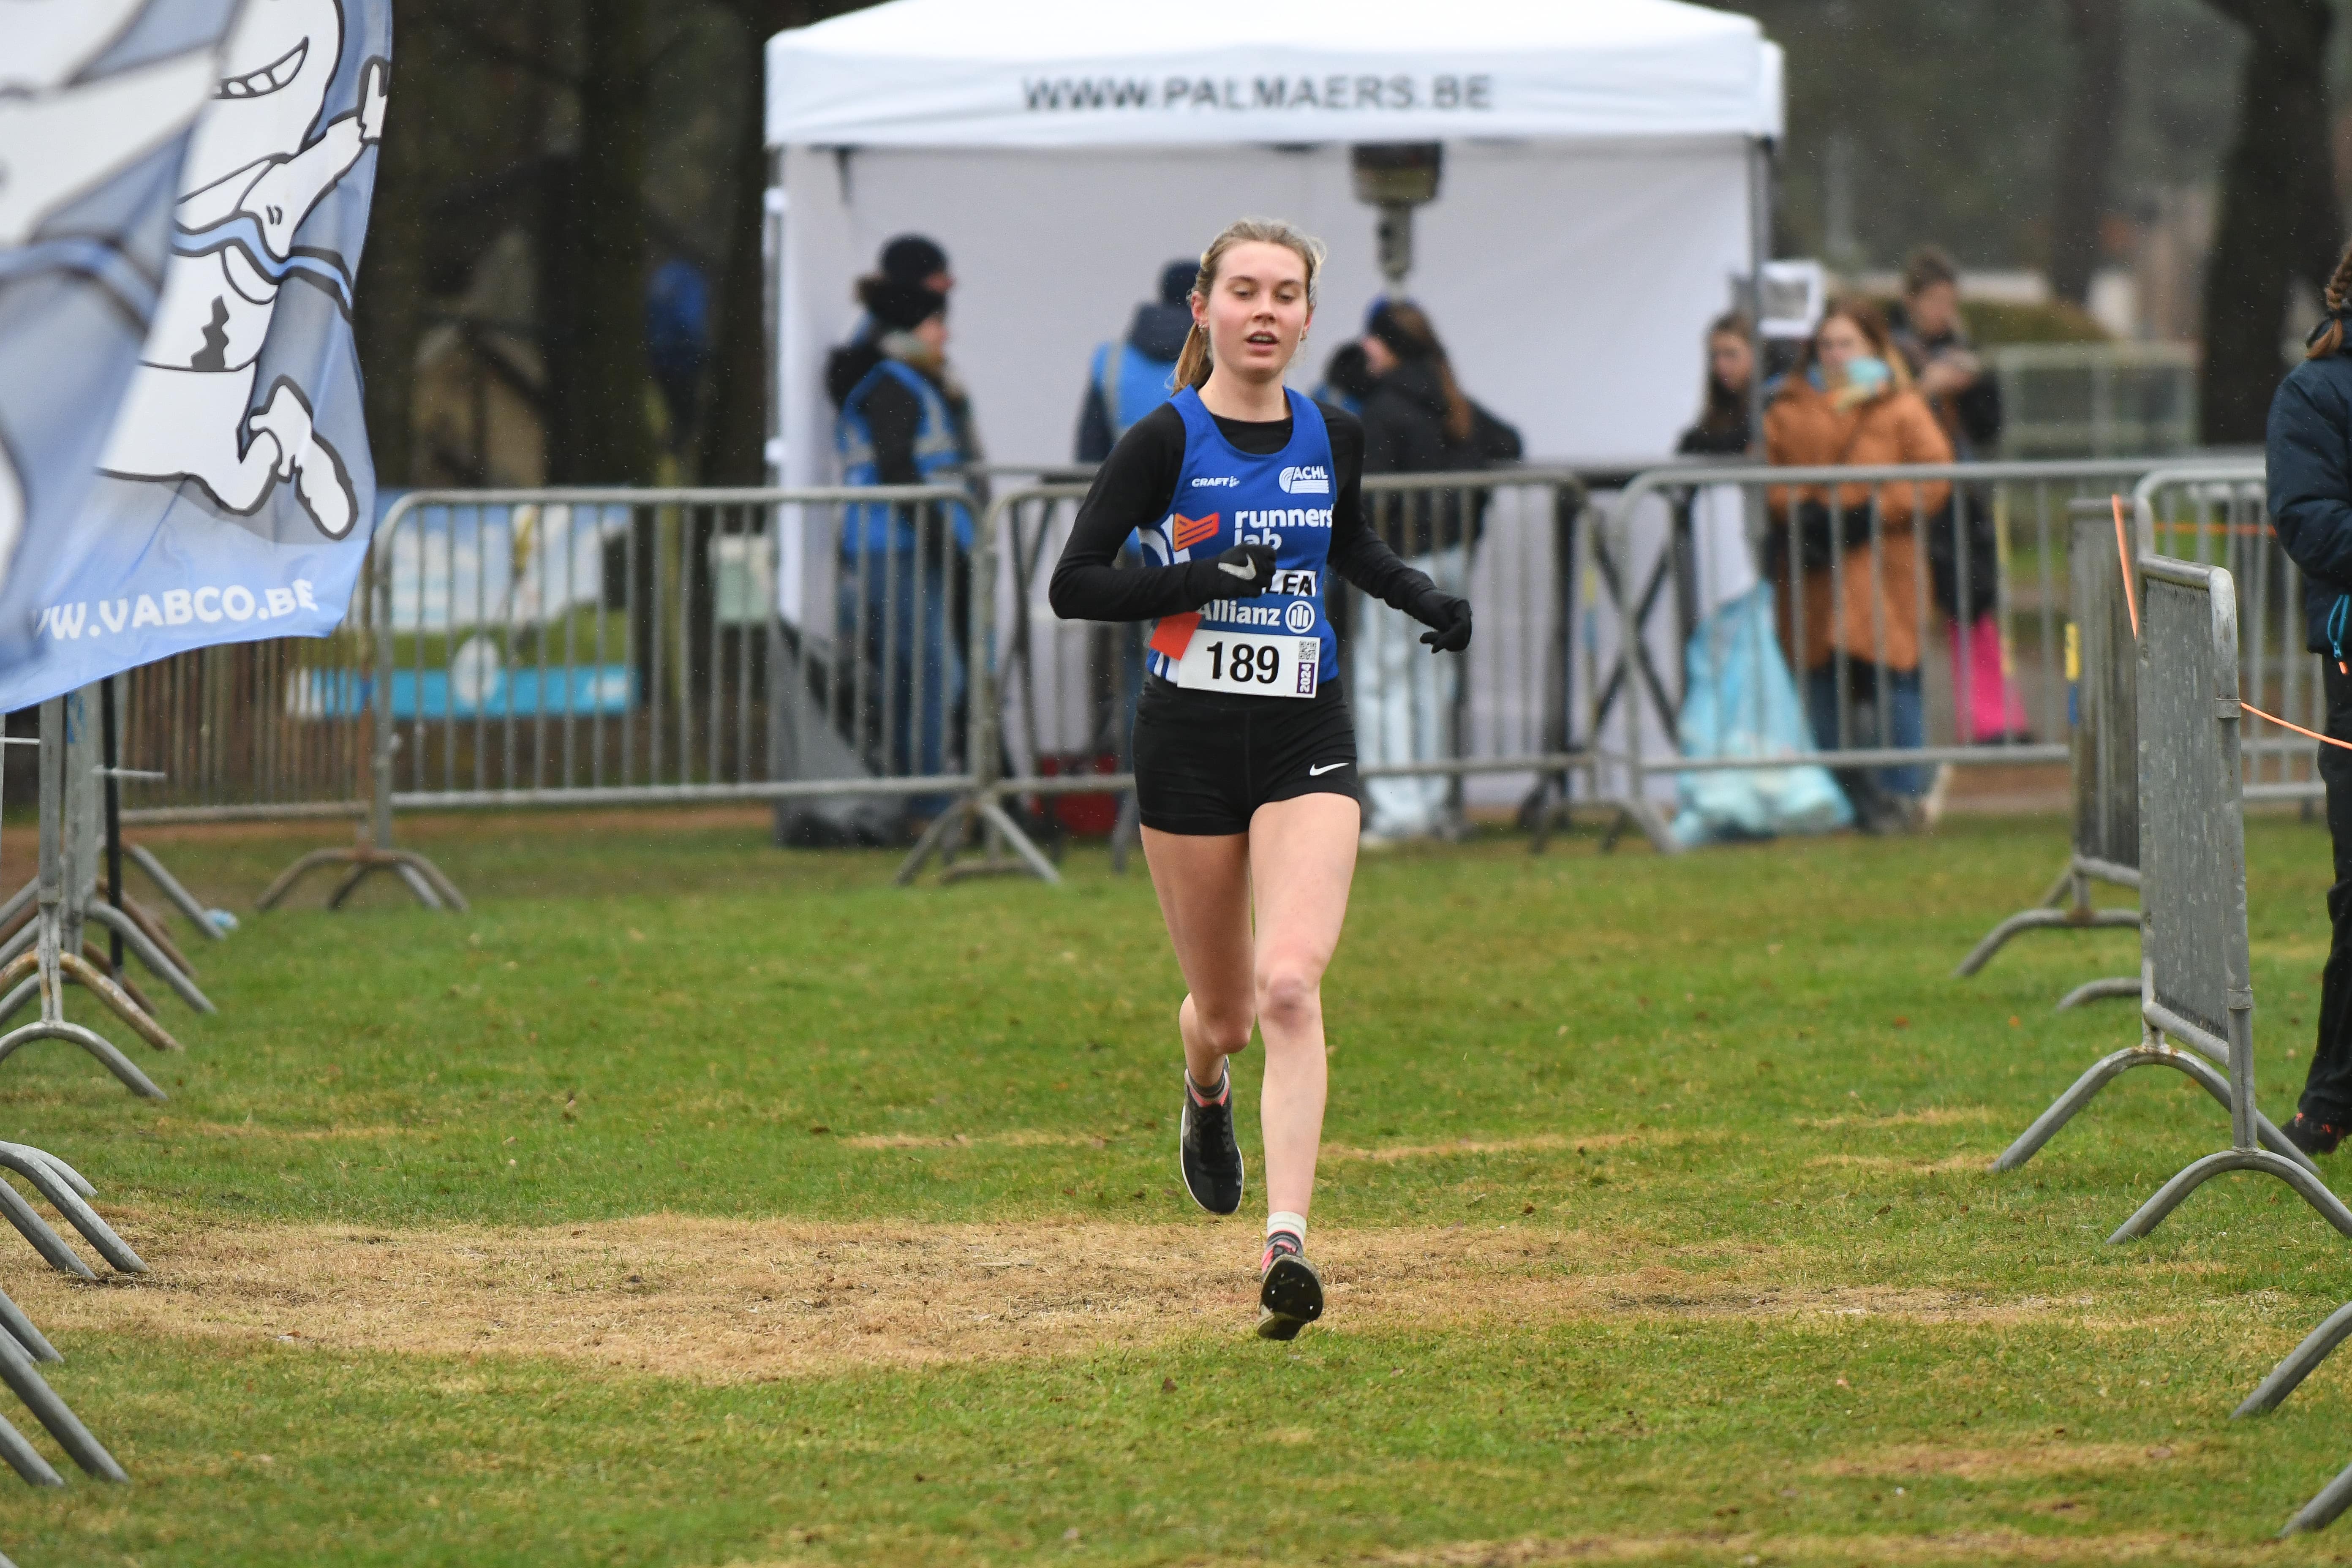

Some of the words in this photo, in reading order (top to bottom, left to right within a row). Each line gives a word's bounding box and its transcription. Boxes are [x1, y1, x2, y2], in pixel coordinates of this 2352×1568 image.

[1023, 74, 1494, 112] WWW.PALMAERS.BE
[1191, 477, 1229, 487] CRAFT
[1234, 528, 1282, 551] lab
[1197, 599, 1281, 626] Allianz
[1206, 641, 1279, 683] 189
[1299, 663, 1312, 693] 2024
